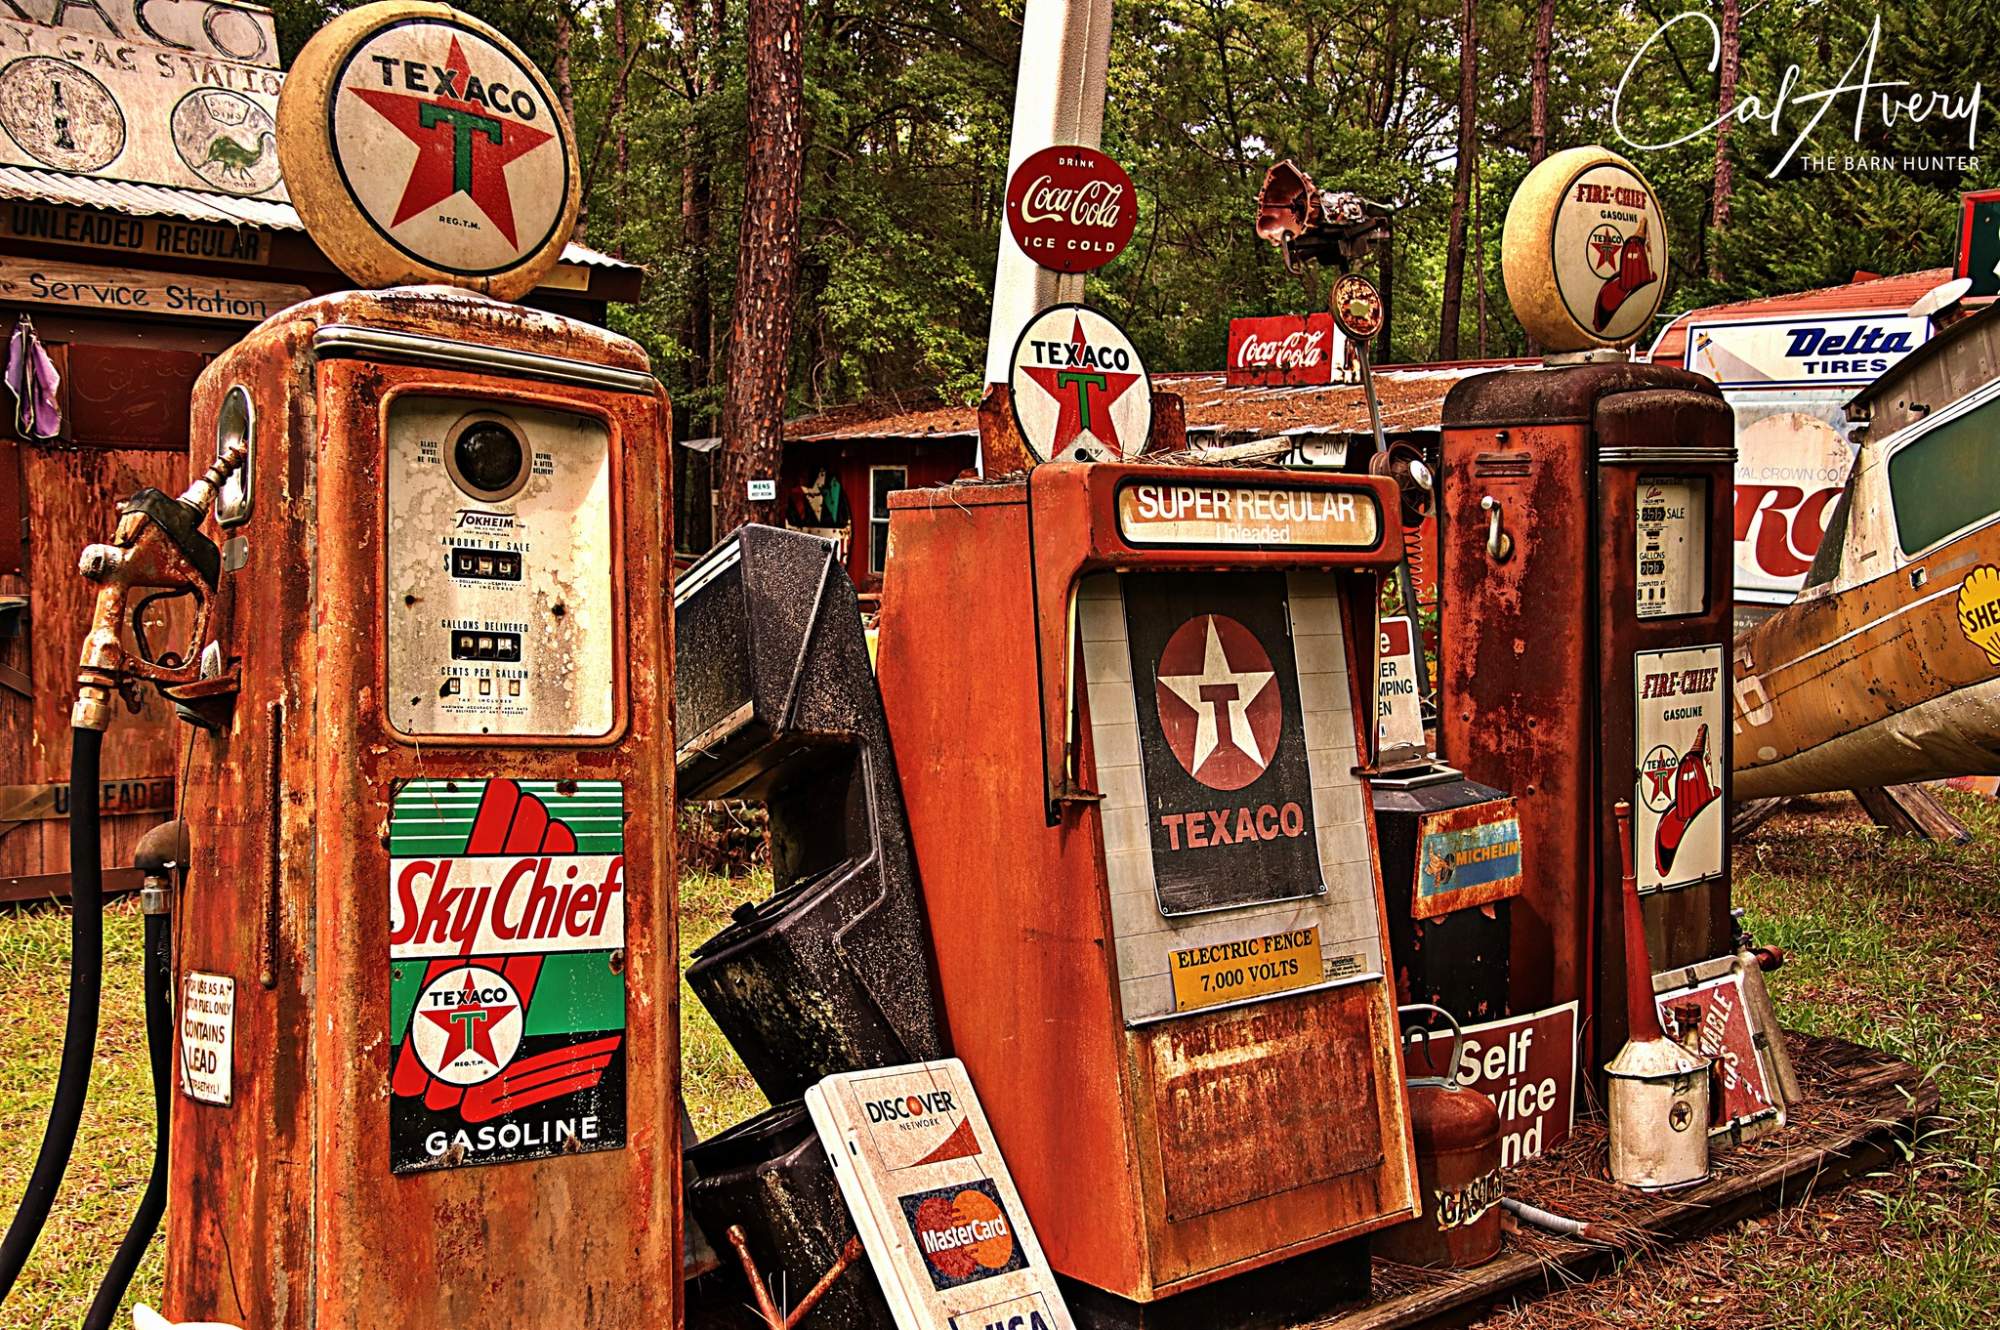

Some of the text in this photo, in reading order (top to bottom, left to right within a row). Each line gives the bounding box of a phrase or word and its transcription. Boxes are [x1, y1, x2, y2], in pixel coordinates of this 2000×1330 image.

[0, 0, 267, 60] ACO
[57, 34, 137, 72] GAS
[155, 52, 281, 97] STATIO
[372, 55, 537, 121] TEXACO
[1058, 157, 1095, 168] DRINK
[1021, 175, 1123, 228] Coca-Cola
[1574, 183, 1648, 210] FIRE-CHIEF
[1600, 210, 1638, 224] GASOLINE
[11, 206, 260, 262] UNLEADED REGULAR
[1024, 236, 1116, 253] ICE COLD
[1593, 234, 1622, 245] TEXACO
[29, 273, 268, 318] Service Station
[1031, 340, 1130, 371] TEXACO
[1237, 331, 1326, 369] Coca-Cola
[1785, 325, 1914, 358] Delta
[1803, 359, 1888, 375] TIRES
[1761, 467, 1813, 481] CROWN
[1137, 485, 1356, 523] SUPER REGULAR
[1666, 507, 1685, 519] SALE
[441, 536, 530, 552] AMOUNT OF SALE
[1216, 523, 1290, 542] Unleaded
[1639, 551, 1665, 560] GALLONS
[441, 619, 529, 632] GALLONS DELIVERED
[1965, 598, 2000, 633] SHE
[441, 666, 529, 679] CENTS PER GALLON
[1641, 667, 1718, 699] FIRE-CHIEF
[1379, 678, 1413, 697] MPING
[1663, 706, 1703, 722] GASOLINE
[1647, 757, 1677, 771] TEXACO
[1161, 802, 1305, 850] TEXACO
[1455, 840, 1519, 868] MICHELIN
[391, 855, 623, 956] Sky Chief
[1177, 928, 1313, 968] ELECTRIC FENCE
[209, 982, 217, 996] AS
[1201, 968, 1244, 994] 7,000
[1249, 957, 1299, 980] VOLTS
[199, 1000, 213, 1014] FUEL
[214, 1001, 231, 1016] ONLY
[430, 987, 508, 1006] TEXACO
[185, 1020, 225, 1044] CONTAINS
[189, 1045, 217, 1075] LEAD
[1456, 1027, 1533, 1086] Self
[866, 1091, 957, 1124] DISCOVER
[1488, 1077, 1557, 1121] vice
[425, 1116, 599, 1156] GASOLINE
[900, 1118, 941, 1132] NETWORK
[922, 1214, 1008, 1254] MasterCard
